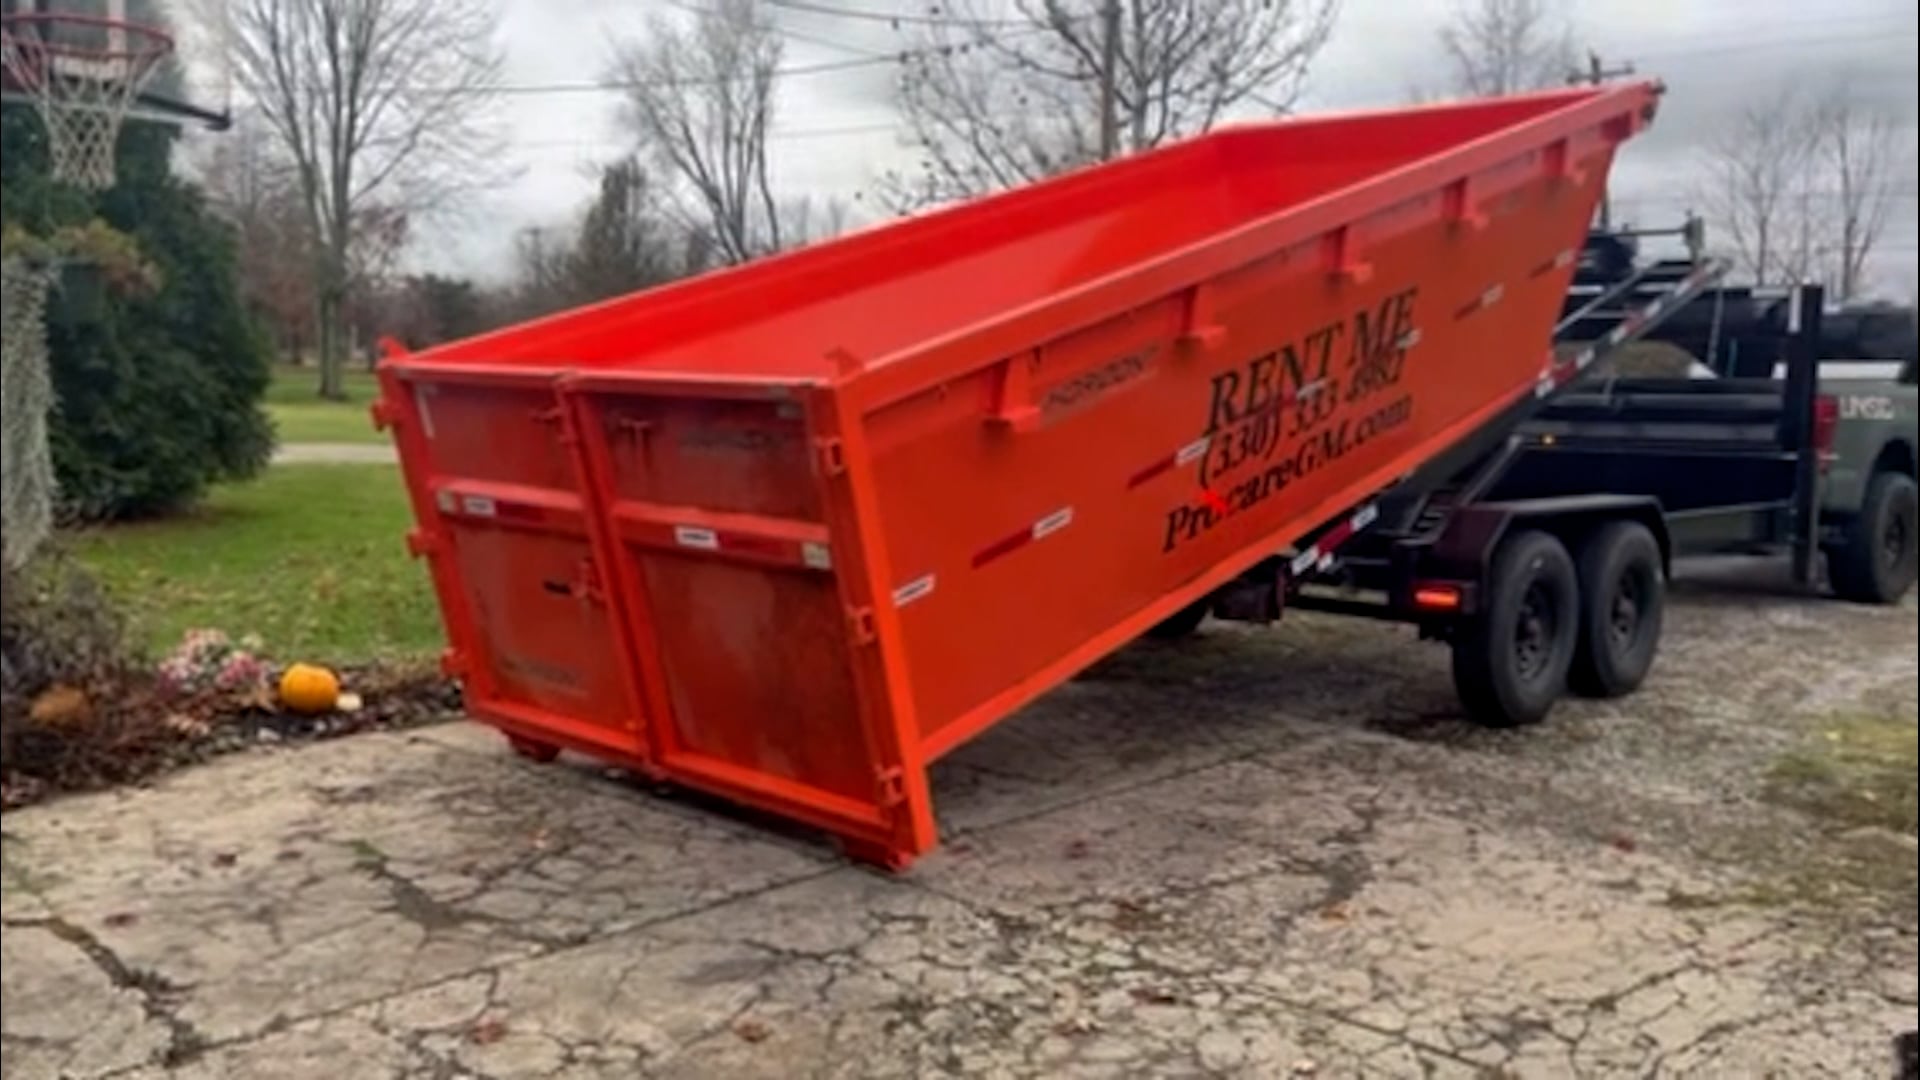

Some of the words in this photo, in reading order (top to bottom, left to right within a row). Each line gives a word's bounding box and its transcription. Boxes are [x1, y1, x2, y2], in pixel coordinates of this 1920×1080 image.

[1206, 321, 1344, 437] RENT
[1345, 288, 1418, 369] ME
[1198, 404, 1282, 490] (330)
